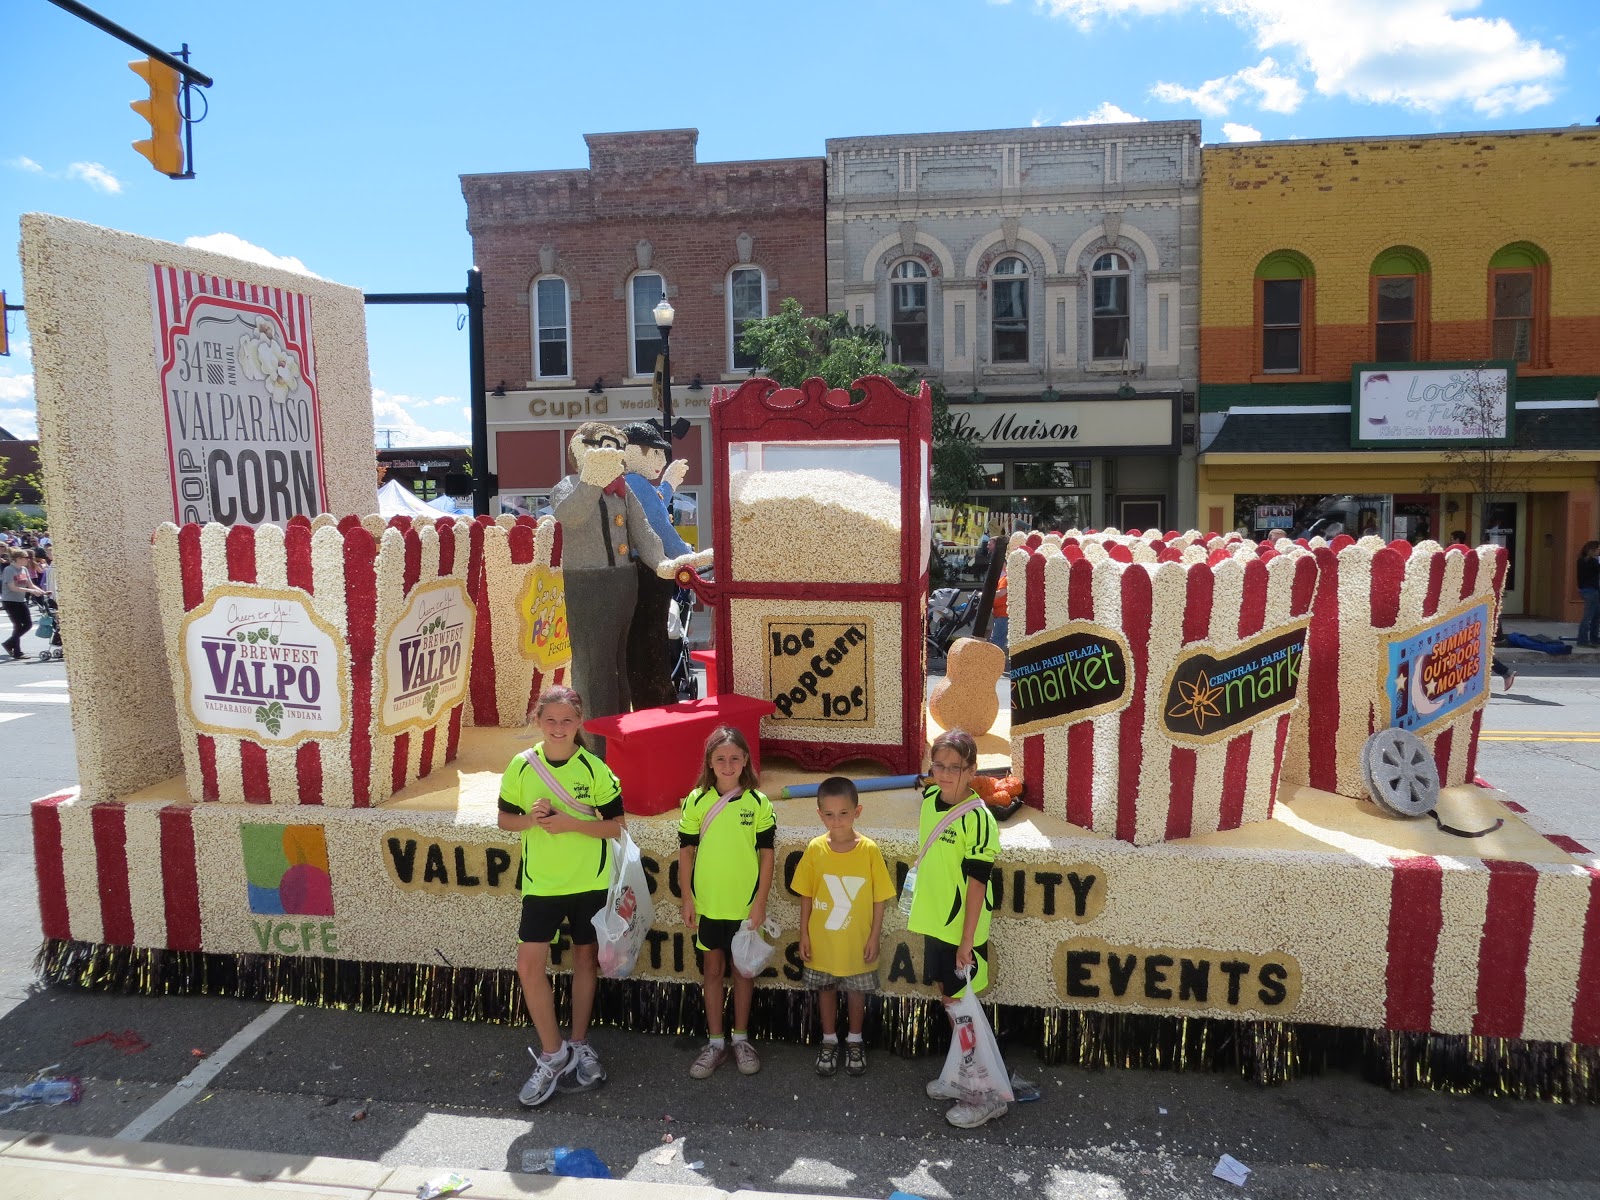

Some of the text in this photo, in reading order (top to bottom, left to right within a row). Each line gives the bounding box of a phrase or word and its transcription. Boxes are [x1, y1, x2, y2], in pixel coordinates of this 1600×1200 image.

[227, 345, 238, 386] ANNUAL
[172, 389, 311, 443] VALPARAISO
[528, 397, 609, 419] Cupid
[976, 412, 1079, 441] Maison
[1406, 405, 1425, 420] of
[1428, 425, 1452, 436] With
[178, 448, 318, 526] POP CORN
[258, 612, 270, 620] to
[240, 644, 319, 665] BREWFEST
[422, 627, 464, 650] BREWFEST
[1432, 621, 1481, 660] SUMMER
[201, 641, 321, 704] VALPO
[399, 639, 461, 692] VALPO
[1010, 643, 1101, 679] ENTRAL PARK PLAZA
[1017, 645, 1119, 708] market
[1209, 662, 1258, 687] CENTRAL
[1261, 648, 1286, 670] PARK
[1226, 646, 1302, 713] mark
[1424, 640, 1480, 682] OUTDOOR
[1437, 658, 1480, 694] MOVIES
[205, 701, 322, 721] VALPARAISO INDIANA
[252, 920, 338, 953] VCFE
[1066, 950, 1288, 1006] EVENTS
